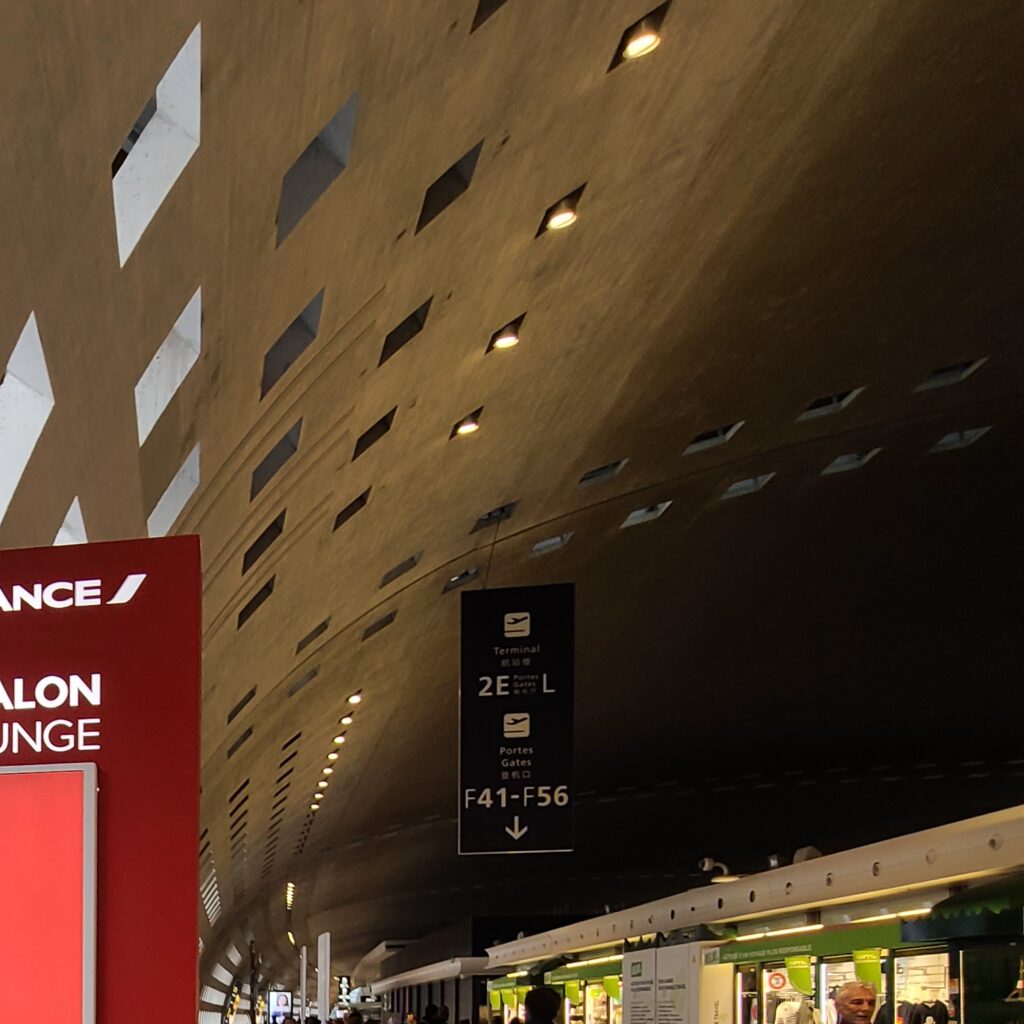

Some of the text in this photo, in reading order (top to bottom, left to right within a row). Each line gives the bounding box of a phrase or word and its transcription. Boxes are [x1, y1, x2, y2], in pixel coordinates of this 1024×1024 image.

[493, 645, 541, 657] Terminal
[478, 673, 556, 697] 2E L
[499, 746, 534, 755] Portes
[501, 758, 532, 767] Gates
[464, 785, 569, 809] F41-F56
